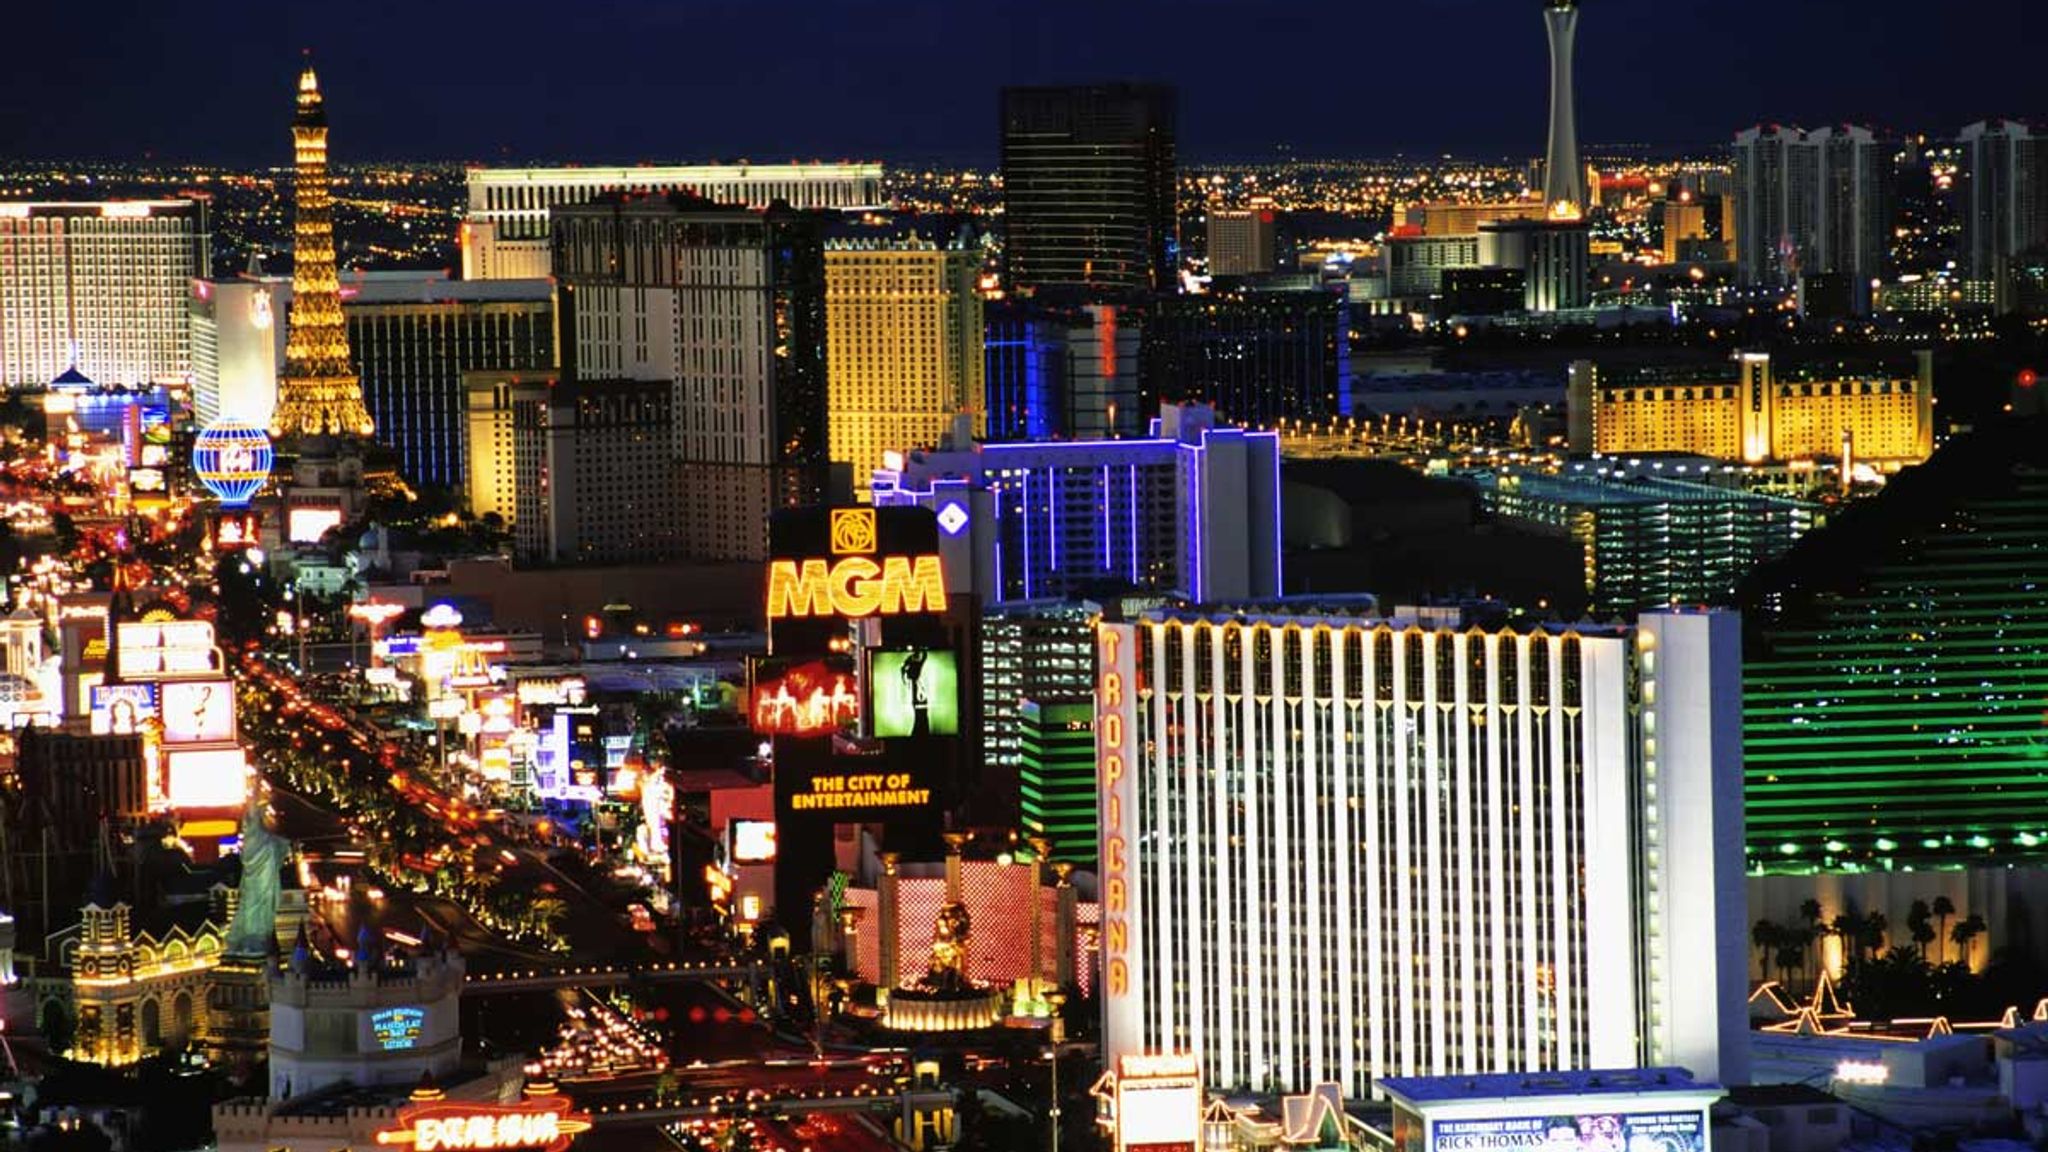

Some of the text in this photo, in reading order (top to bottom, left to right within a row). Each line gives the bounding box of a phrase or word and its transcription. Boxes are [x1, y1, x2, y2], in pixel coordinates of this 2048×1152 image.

[767, 556, 947, 617] MGM
[812, 774, 910, 792] THE CITY OF
[792, 789, 930, 809] ENTERTAINMENT
[1103, 630, 1130, 996] TROPICANA
[414, 1112, 559, 1151] EXCALIBUR
[1439, 1133, 1545, 1150] RICK THOMAS
